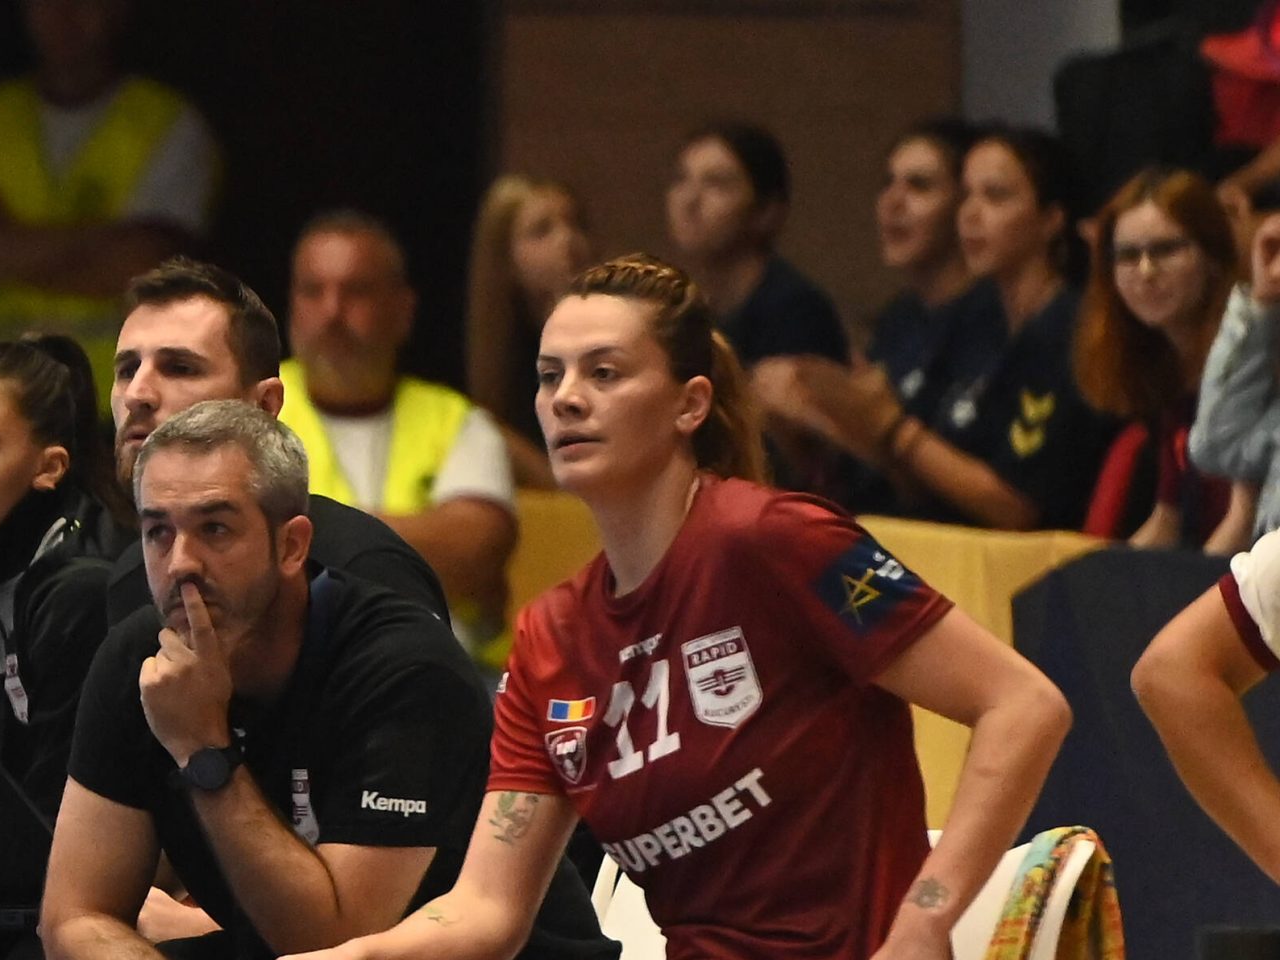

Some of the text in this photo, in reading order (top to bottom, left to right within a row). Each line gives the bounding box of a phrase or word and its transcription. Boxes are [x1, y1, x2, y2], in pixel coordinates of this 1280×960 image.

[690, 641, 738, 665] RAPID
[603, 659, 681, 778] 11
[361, 790, 427, 817] Kempa
